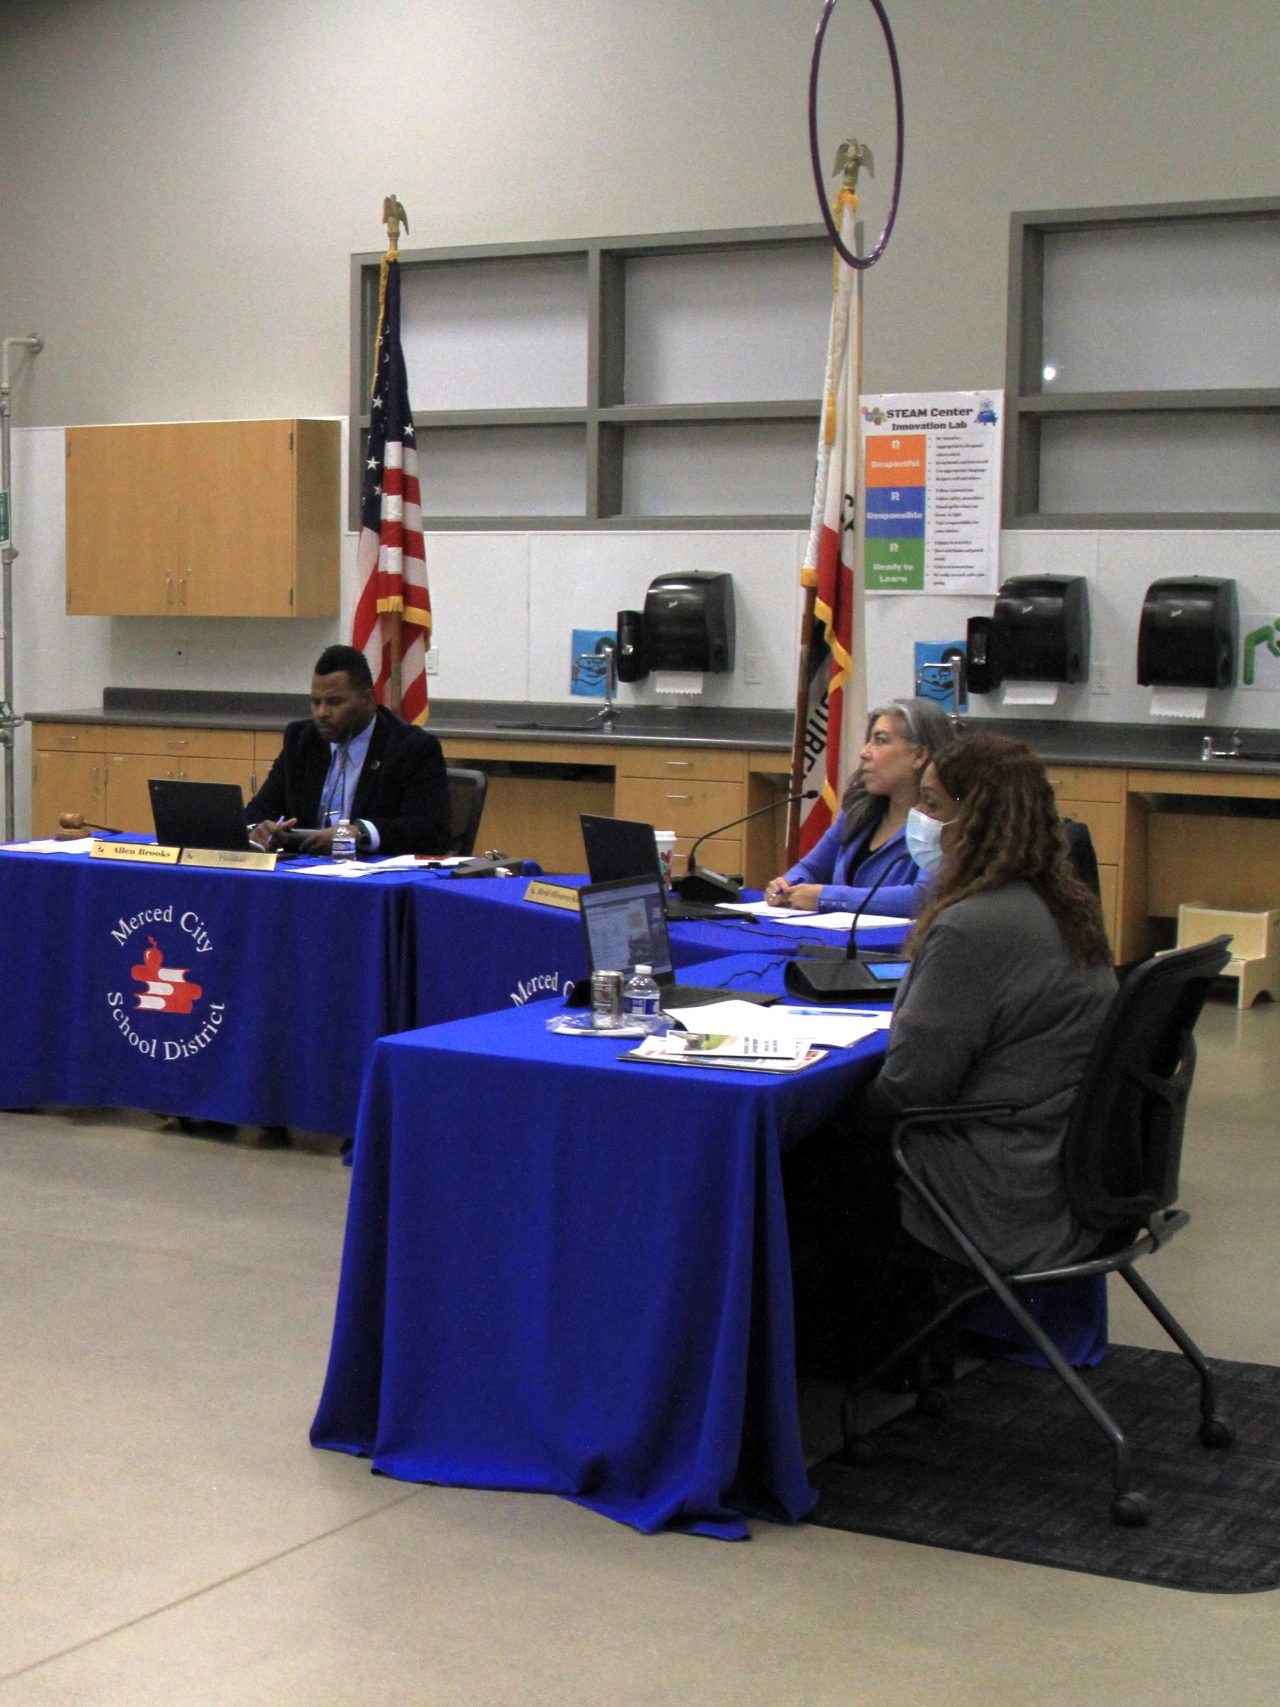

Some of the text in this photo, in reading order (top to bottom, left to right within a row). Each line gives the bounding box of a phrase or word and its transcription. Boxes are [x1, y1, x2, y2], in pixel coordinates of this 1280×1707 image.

[886, 408, 974, 419] STEAM Center
[891, 421, 968, 431] Innovation Lab
[113, 846, 171, 857] Allen Brooks
[110, 905, 214, 953] Merced City
[509, 971, 559, 1008] Merced
[107, 991, 226, 1061] School District
